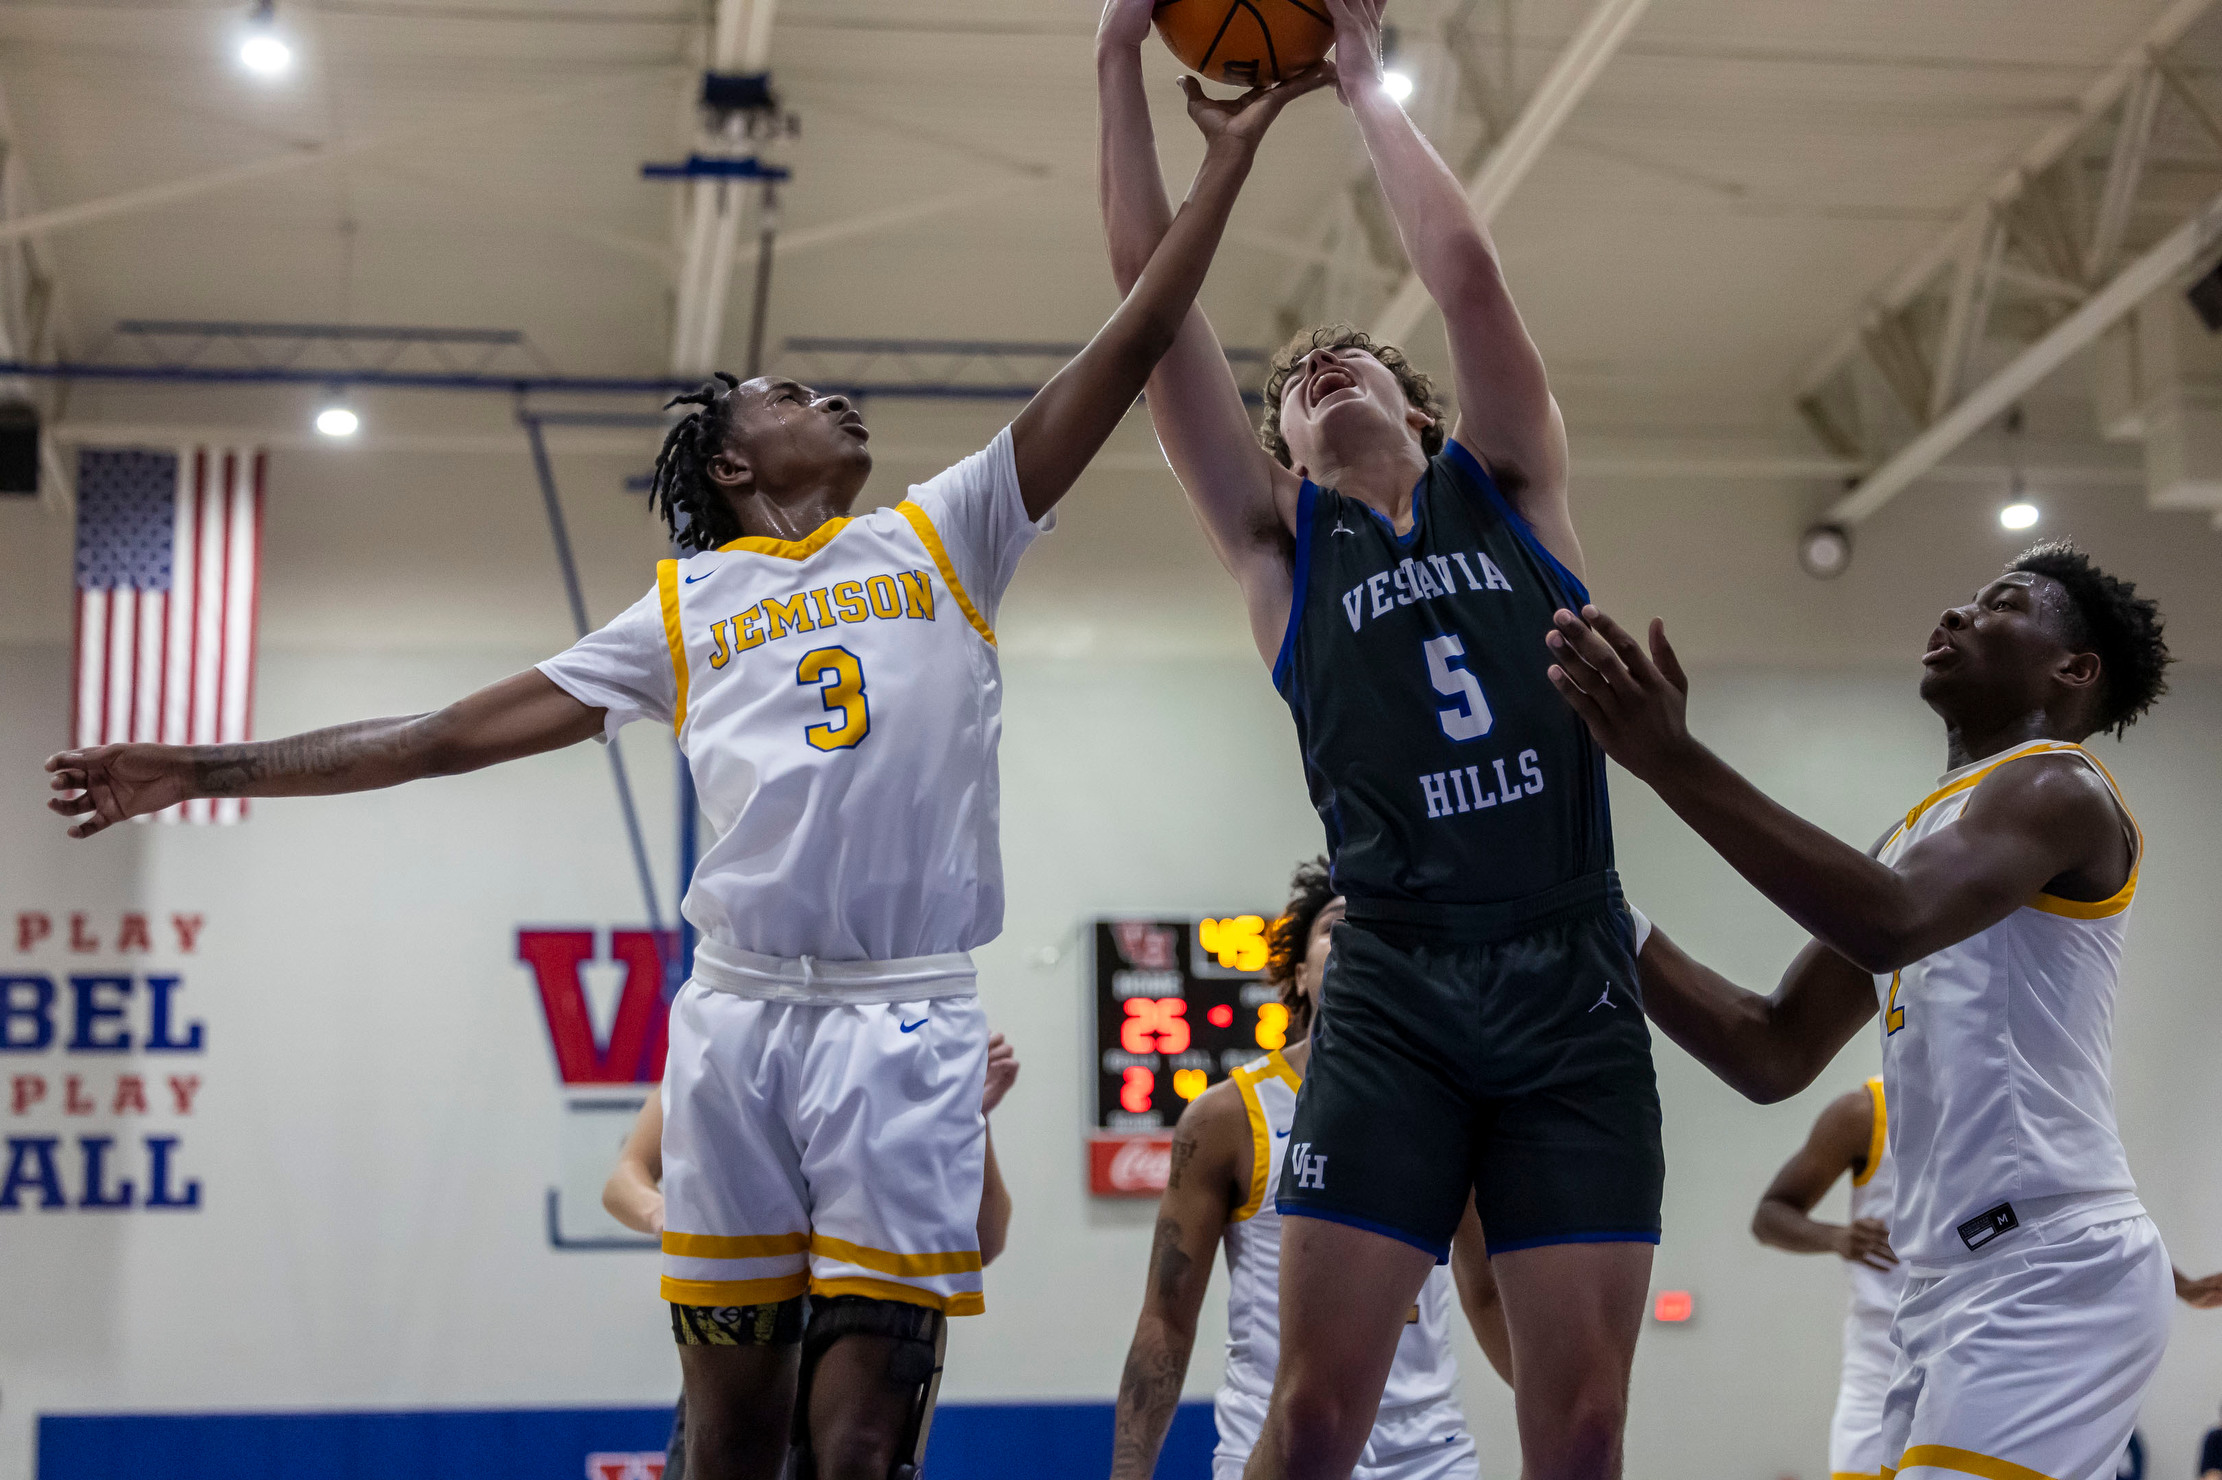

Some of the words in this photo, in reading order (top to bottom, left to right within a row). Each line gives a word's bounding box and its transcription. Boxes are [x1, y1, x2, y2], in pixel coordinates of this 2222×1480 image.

[709, 570, 935, 670] JEMISON
[1342, 552, 1513, 633] VESTAVIA
[796, 645, 871, 752] 3
[1423, 634, 1494, 742] 5
[1419, 749, 1544, 818] HILLS
[15, 911, 207, 953] PLAY
[10, 1073, 202, 1116] PLAY
[0, 1133, 203, 1213] ALL
[1291, 1142, 1328, 1189] VH
[1996, 1213, 2009, 1226] M
